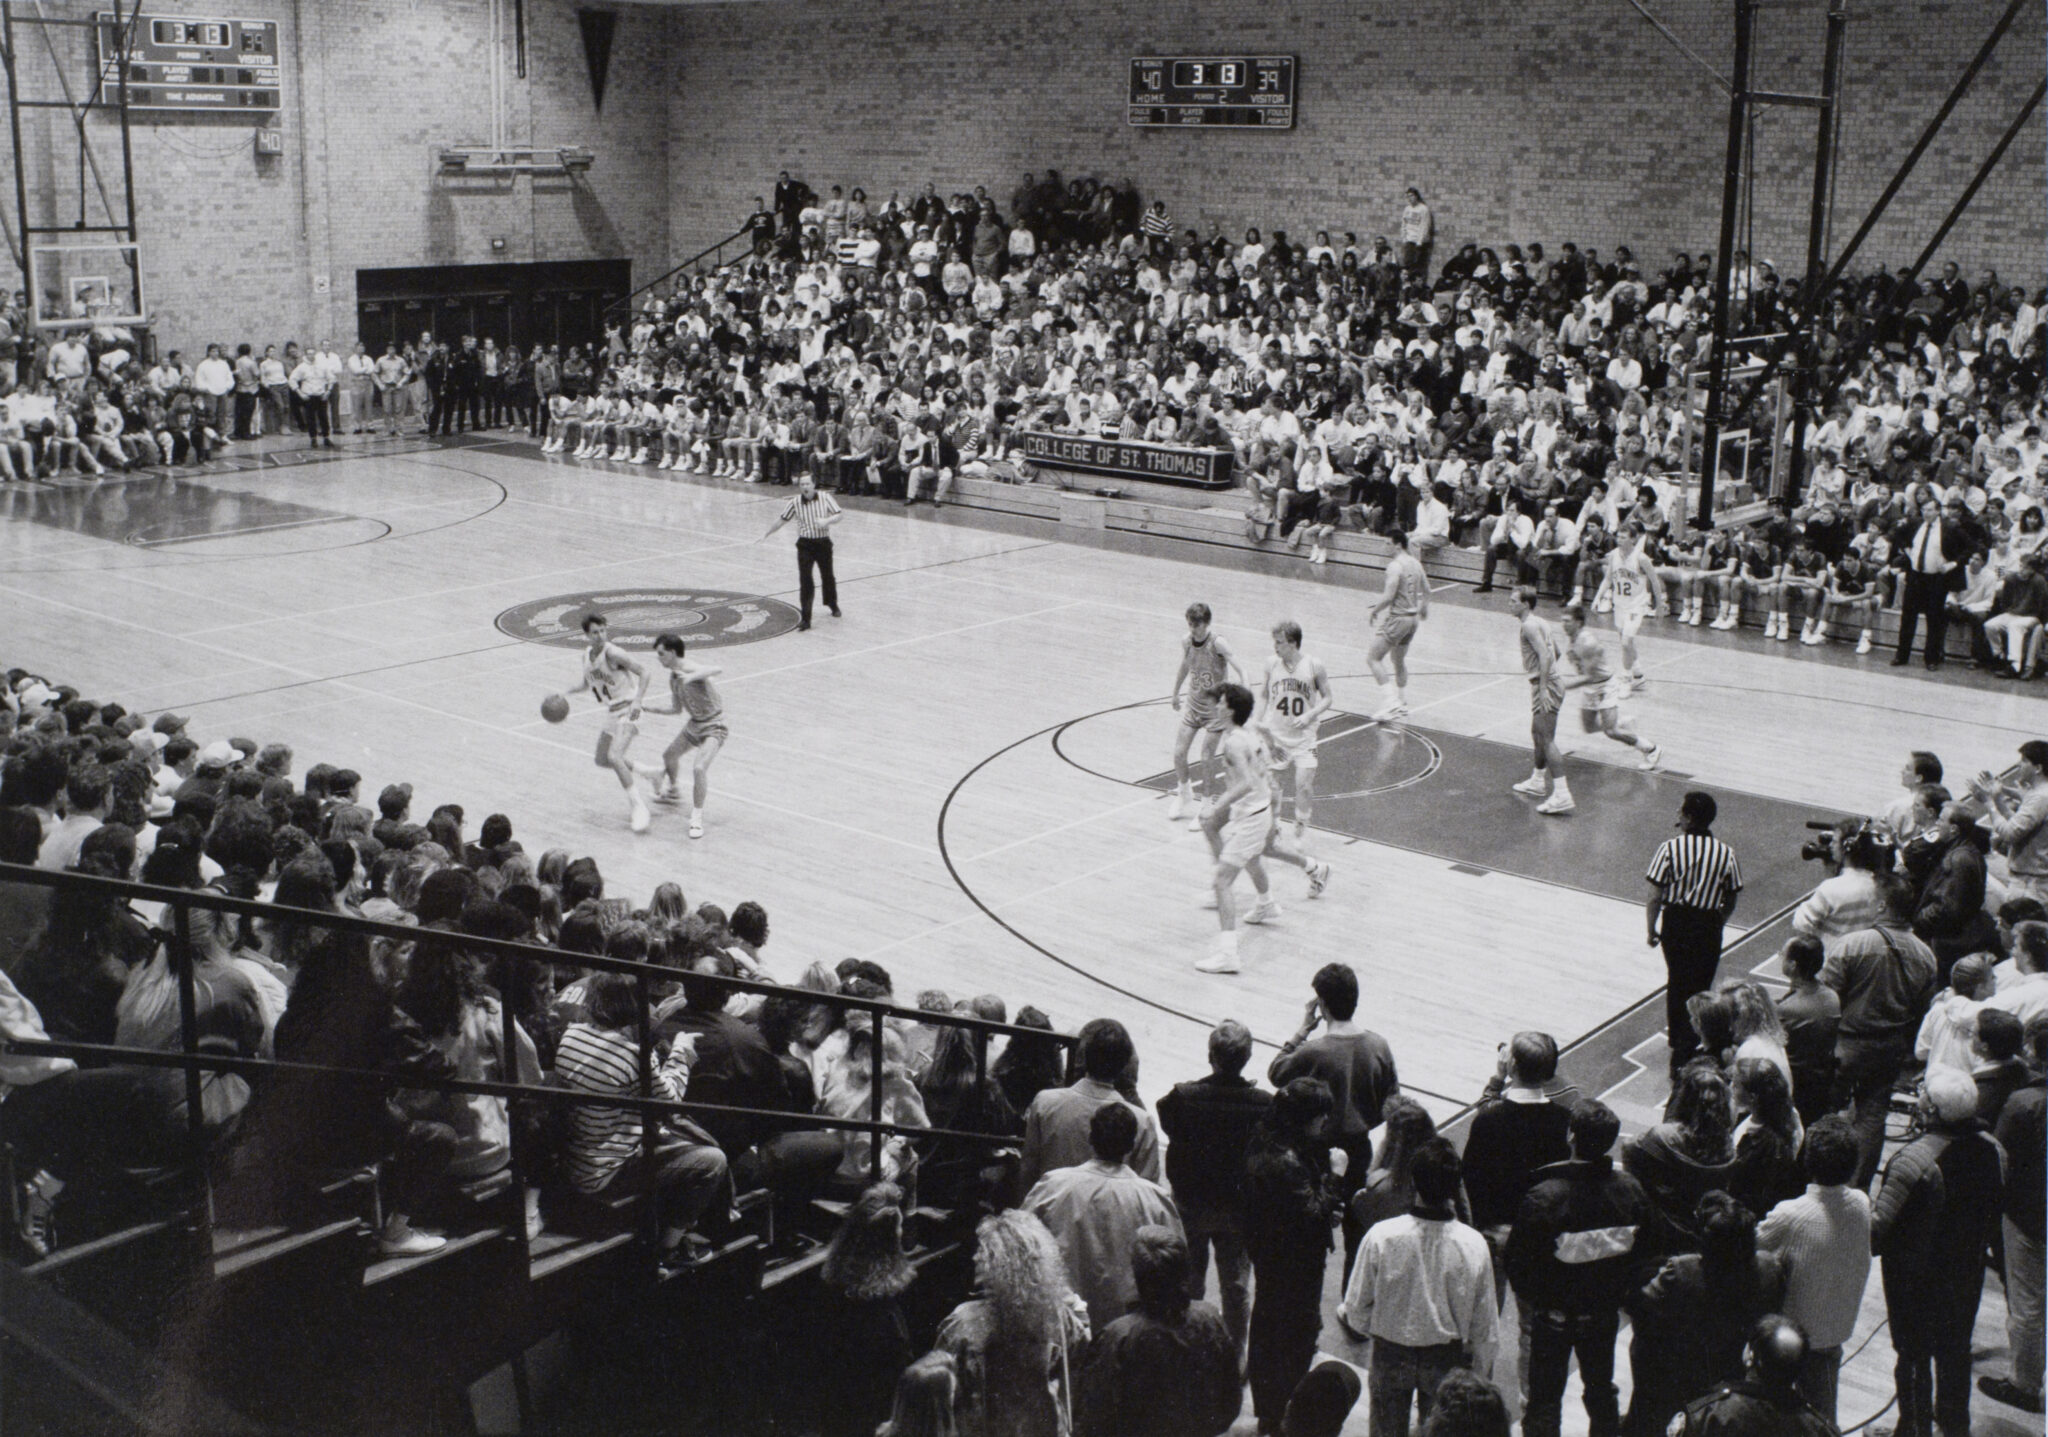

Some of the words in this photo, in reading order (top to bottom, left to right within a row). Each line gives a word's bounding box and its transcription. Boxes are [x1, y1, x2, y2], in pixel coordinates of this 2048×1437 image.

[237, 54, 273, 65] VISITOR
[1142, 71, 1161, 89] 40
[1258, 70, 1278, 90] 39
[1136, 93, 1165, 103] HOME
[1218, 89, 1227, 104] 2
[1250, 94, 1285, 104] VISITOR
[260, 130, 281, 151] 40
[1027, 437, 1092, 462] COLLEGE
[1097, 446, 1116, 465] OF
[1120, 449, 1141, 468] ST.
[1145, 451, 1207, 475] THOMAS
[1617, 581, 1631, 596] 12
[1281, 677, 1311, 701] THOMAS
[1276, 696, 1304, 717] 40
